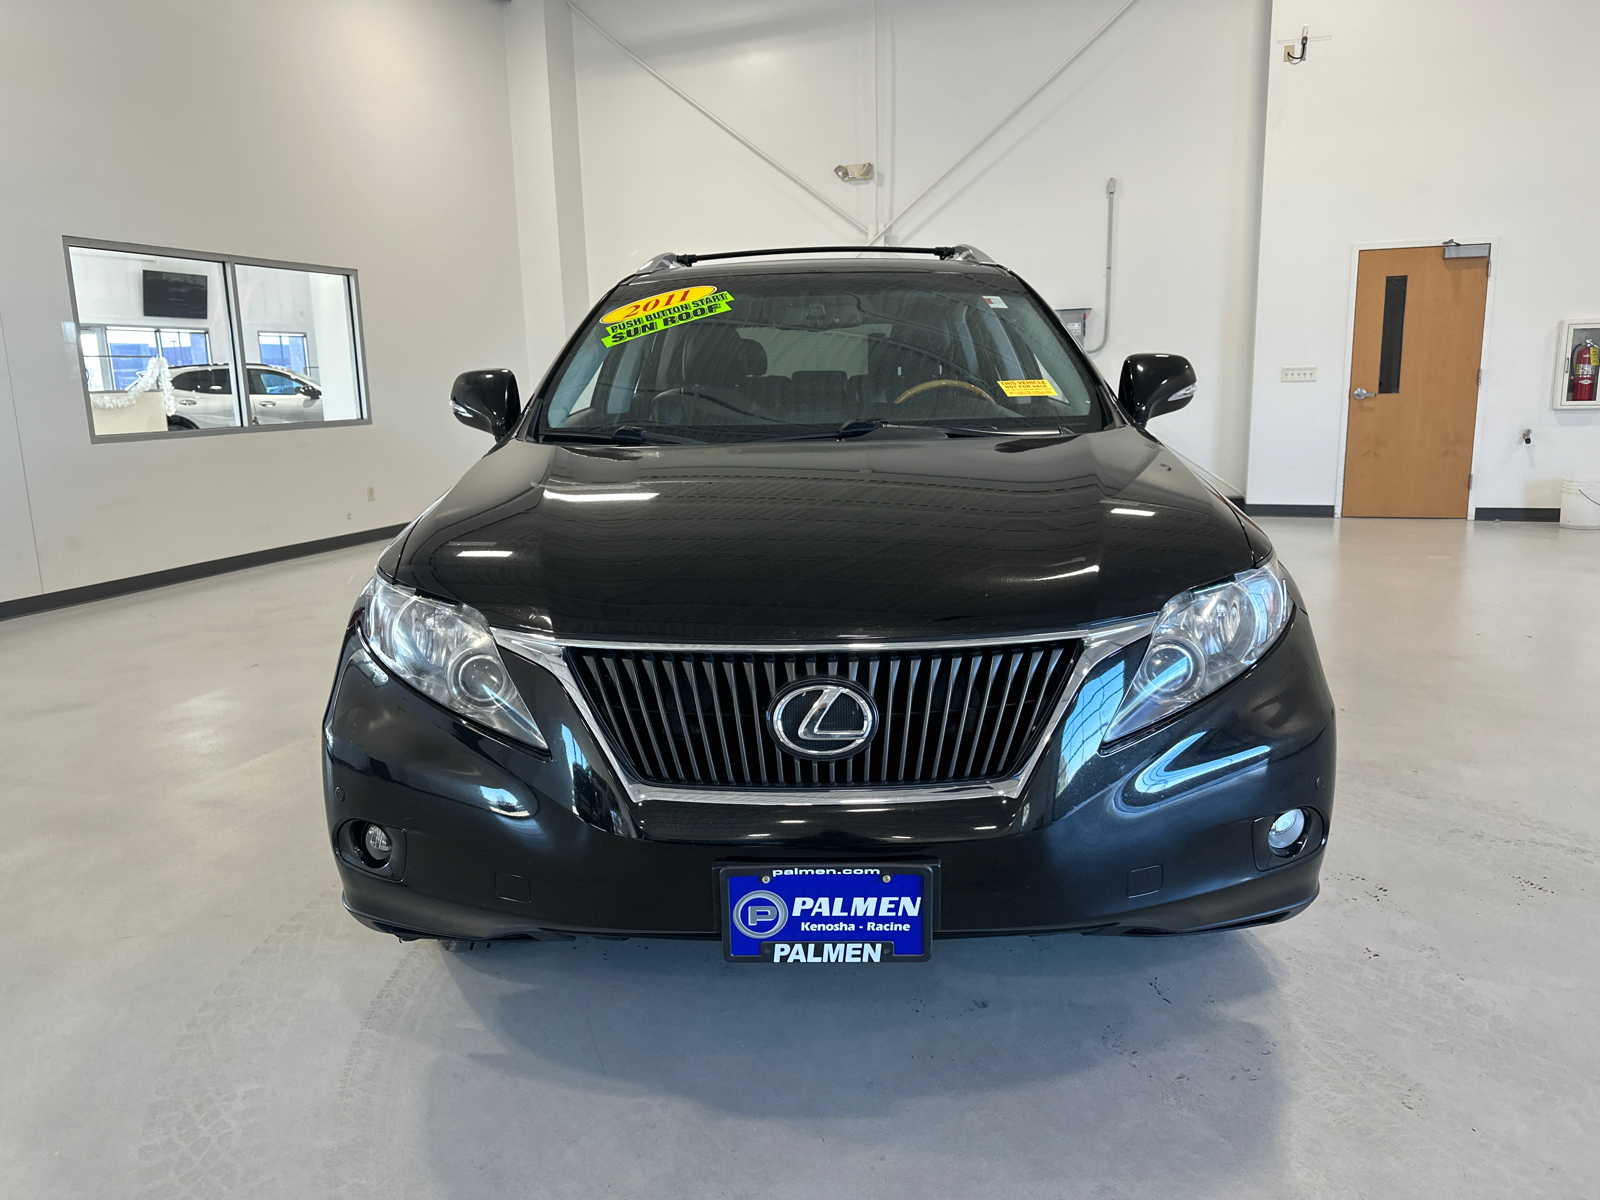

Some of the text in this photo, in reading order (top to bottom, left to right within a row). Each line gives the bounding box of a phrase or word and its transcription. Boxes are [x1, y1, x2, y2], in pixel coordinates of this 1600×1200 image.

[610, 292, 727, 333] PUSH BUTTON START
[623, 289, 691, 319] 2011
[611, 303, 721, 343] SUN ROOF
[772, 867, 881, 877] palmen.com
[747, 905, 778, 926] P
[792, 896, 922, 917] PALMEN
[801, 921, 856, 932] Kenosha
[867, 921, 911, 932] Racine
[773, 943, 882, 963] PALMEN
